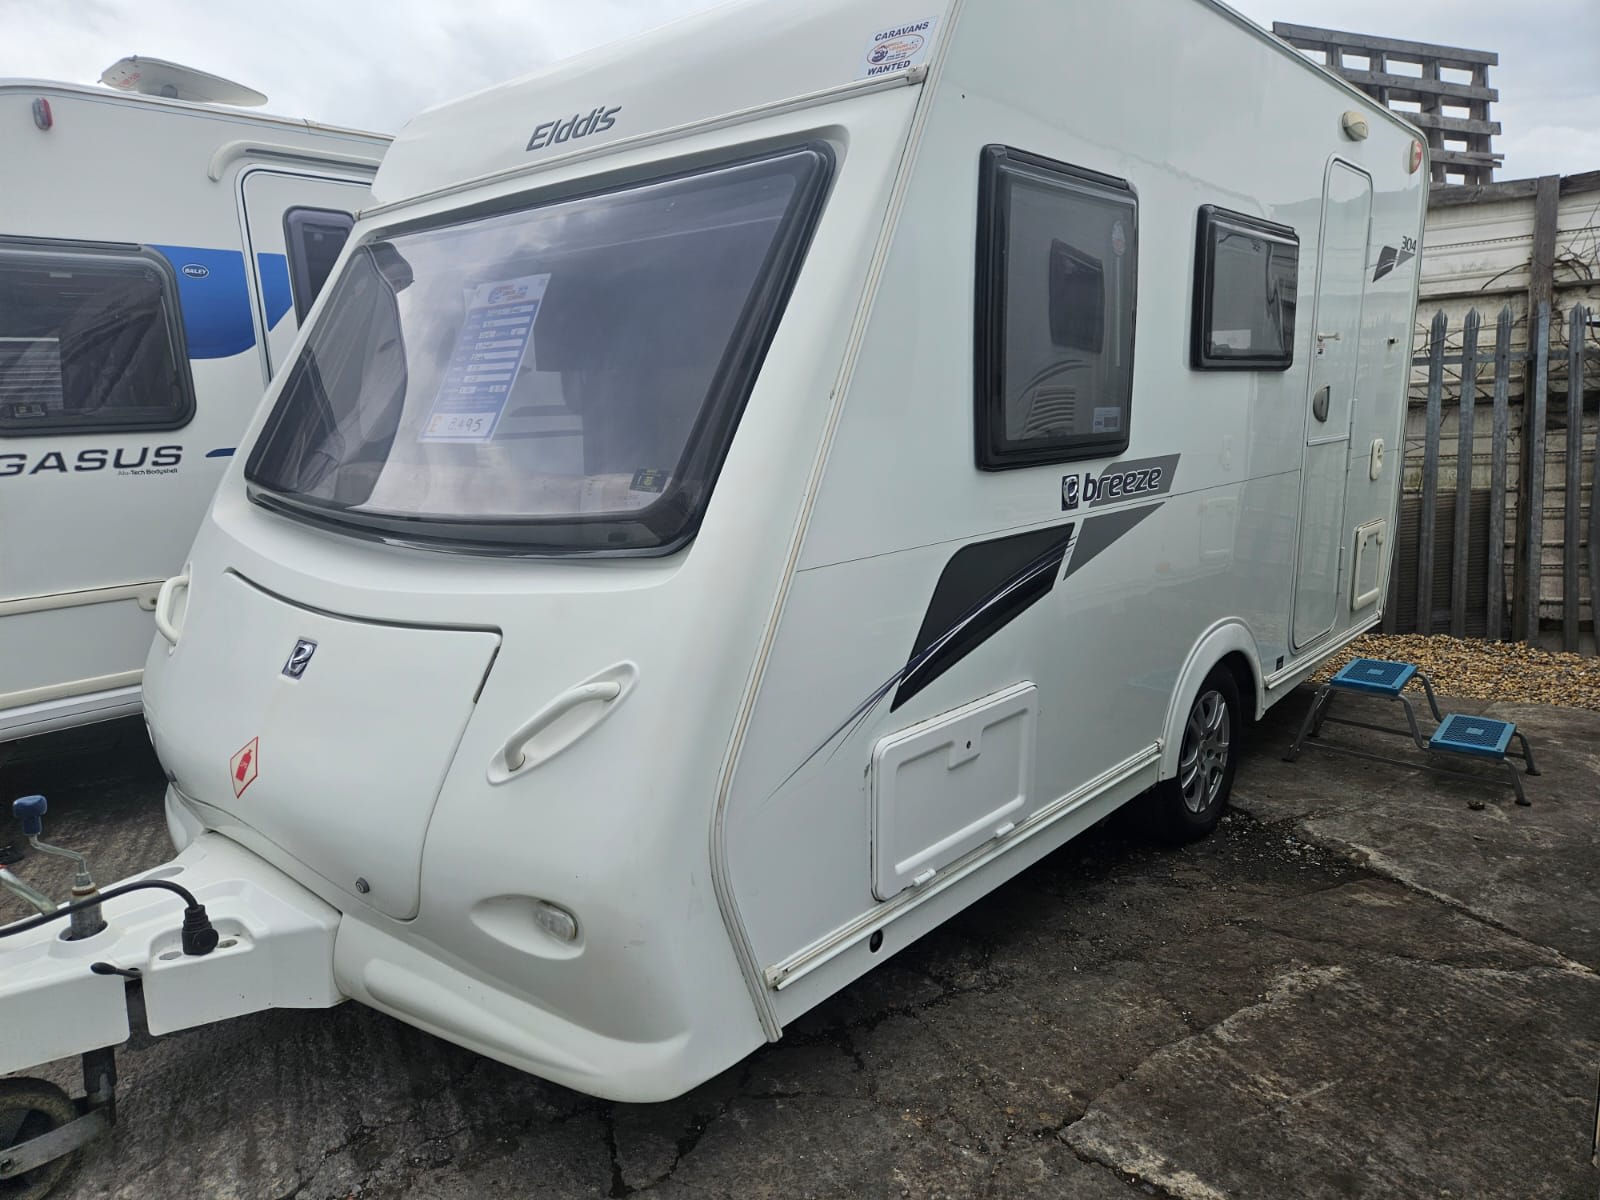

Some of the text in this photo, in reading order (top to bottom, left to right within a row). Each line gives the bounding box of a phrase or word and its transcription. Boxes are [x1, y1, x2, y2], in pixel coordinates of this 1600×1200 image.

[875, 21, 929, 41] CARAVANS
[867, 60, 911, 76] WANTED
[526, 105, 622, 151] Elddis
[1401, 235, 1417, 252] 304
[184, 267, 206, 275] BAILEY
[0, 445, 183, 477] GASUS
[1082, 467, 1162, 502] breeze
